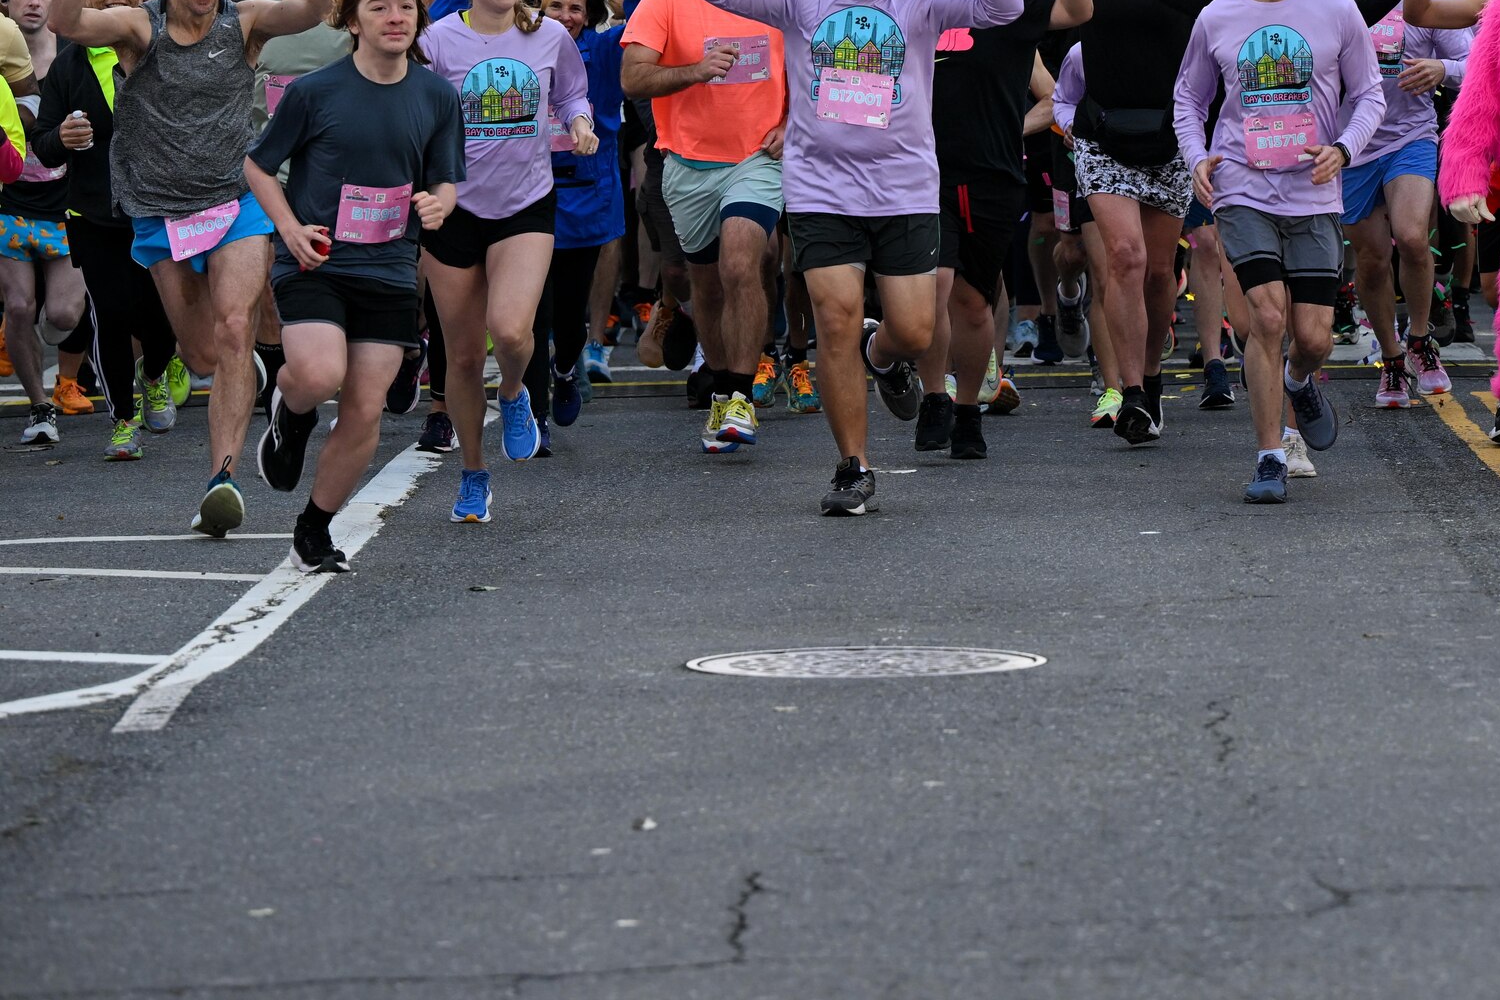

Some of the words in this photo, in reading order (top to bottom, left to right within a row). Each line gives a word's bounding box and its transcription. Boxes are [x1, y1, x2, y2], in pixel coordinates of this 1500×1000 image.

[738, 52, 761, 67] 215
[828, 87, 883, 107] B17001
[1244, 95, 1260, 104] BAY
[1260, 93, 1272, 103] TO
[1273, 91, 1310, 102] BREAKERS
[465, 127, 482, 136] BAY
[484, 127, 495, 137] TO
[1256, 132, 1308, 150] B15716
[351, 206, 401, 222] B15912
[177, 213, 235, 240] B16065
